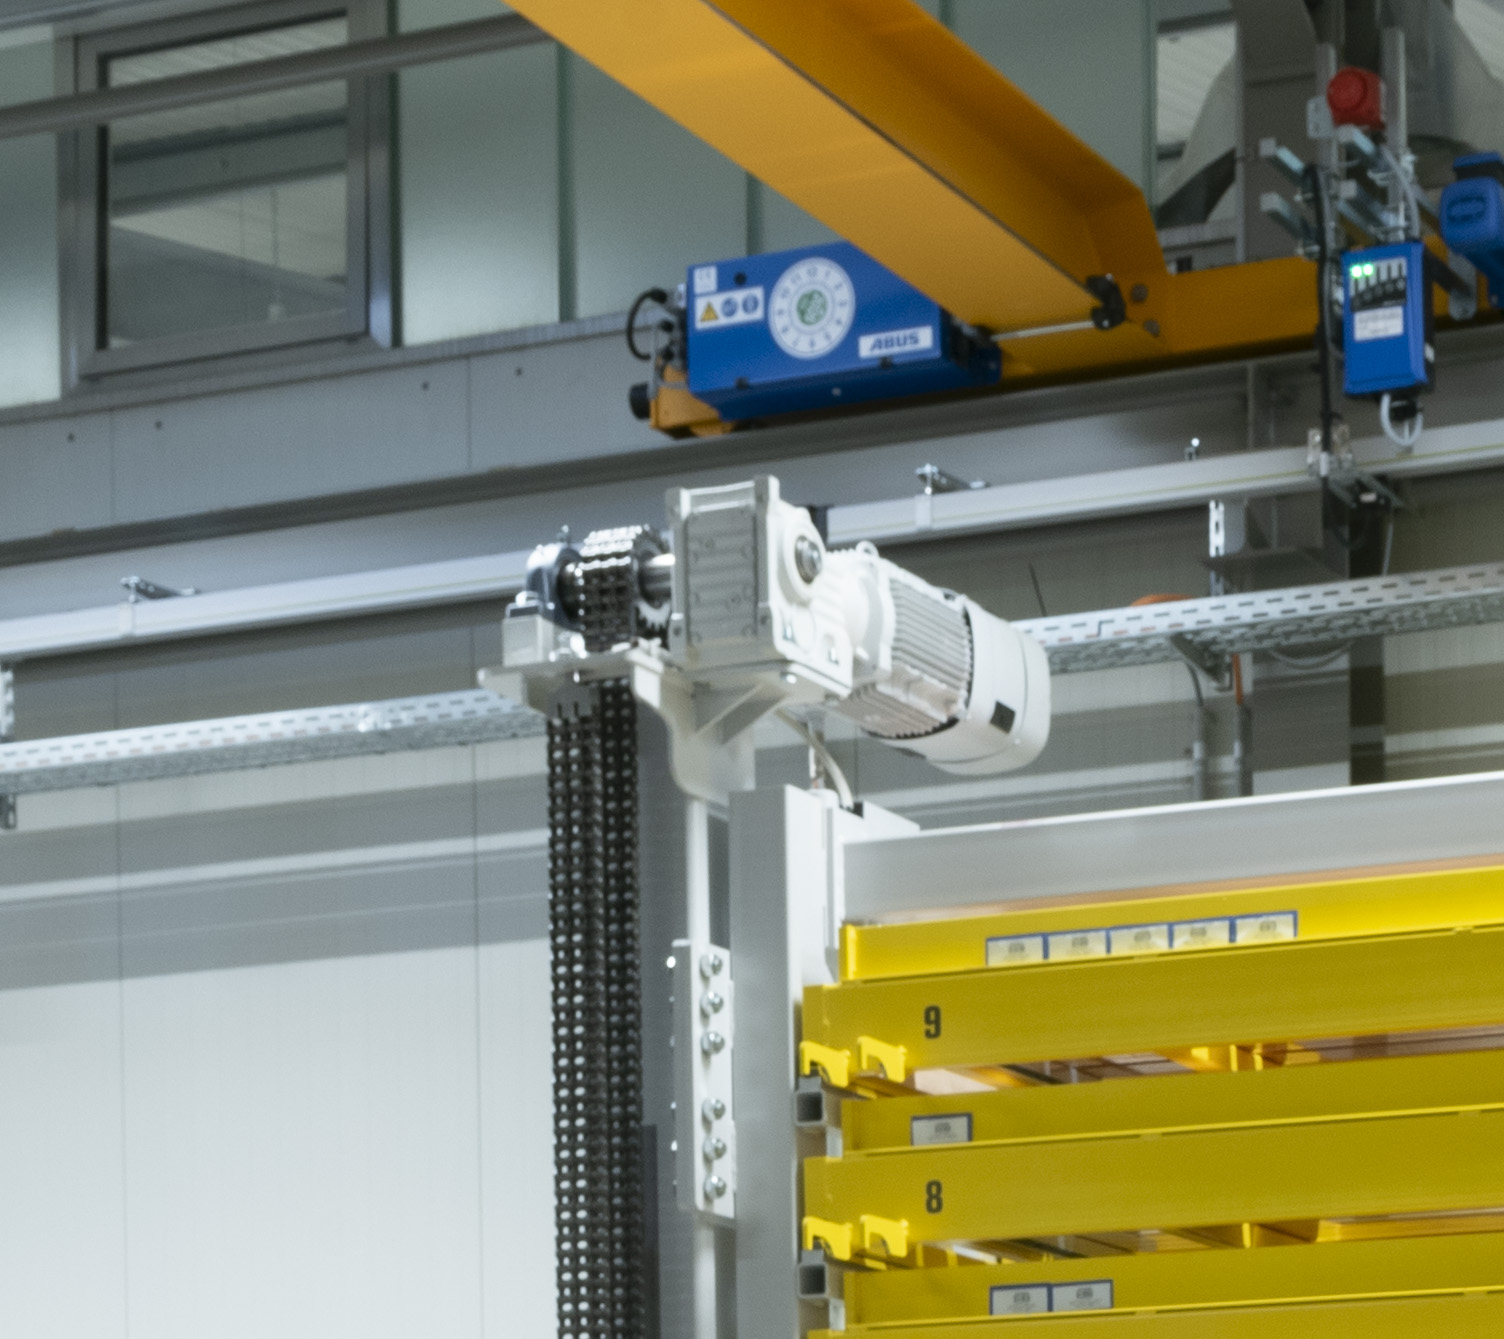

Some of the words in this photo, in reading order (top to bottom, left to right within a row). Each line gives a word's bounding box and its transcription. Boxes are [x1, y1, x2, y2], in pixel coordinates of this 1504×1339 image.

[870, 330, 920, 352] ABUS
[924, 1005, 942, 1039] 9
[925, 1180, 943, 1214] 8
